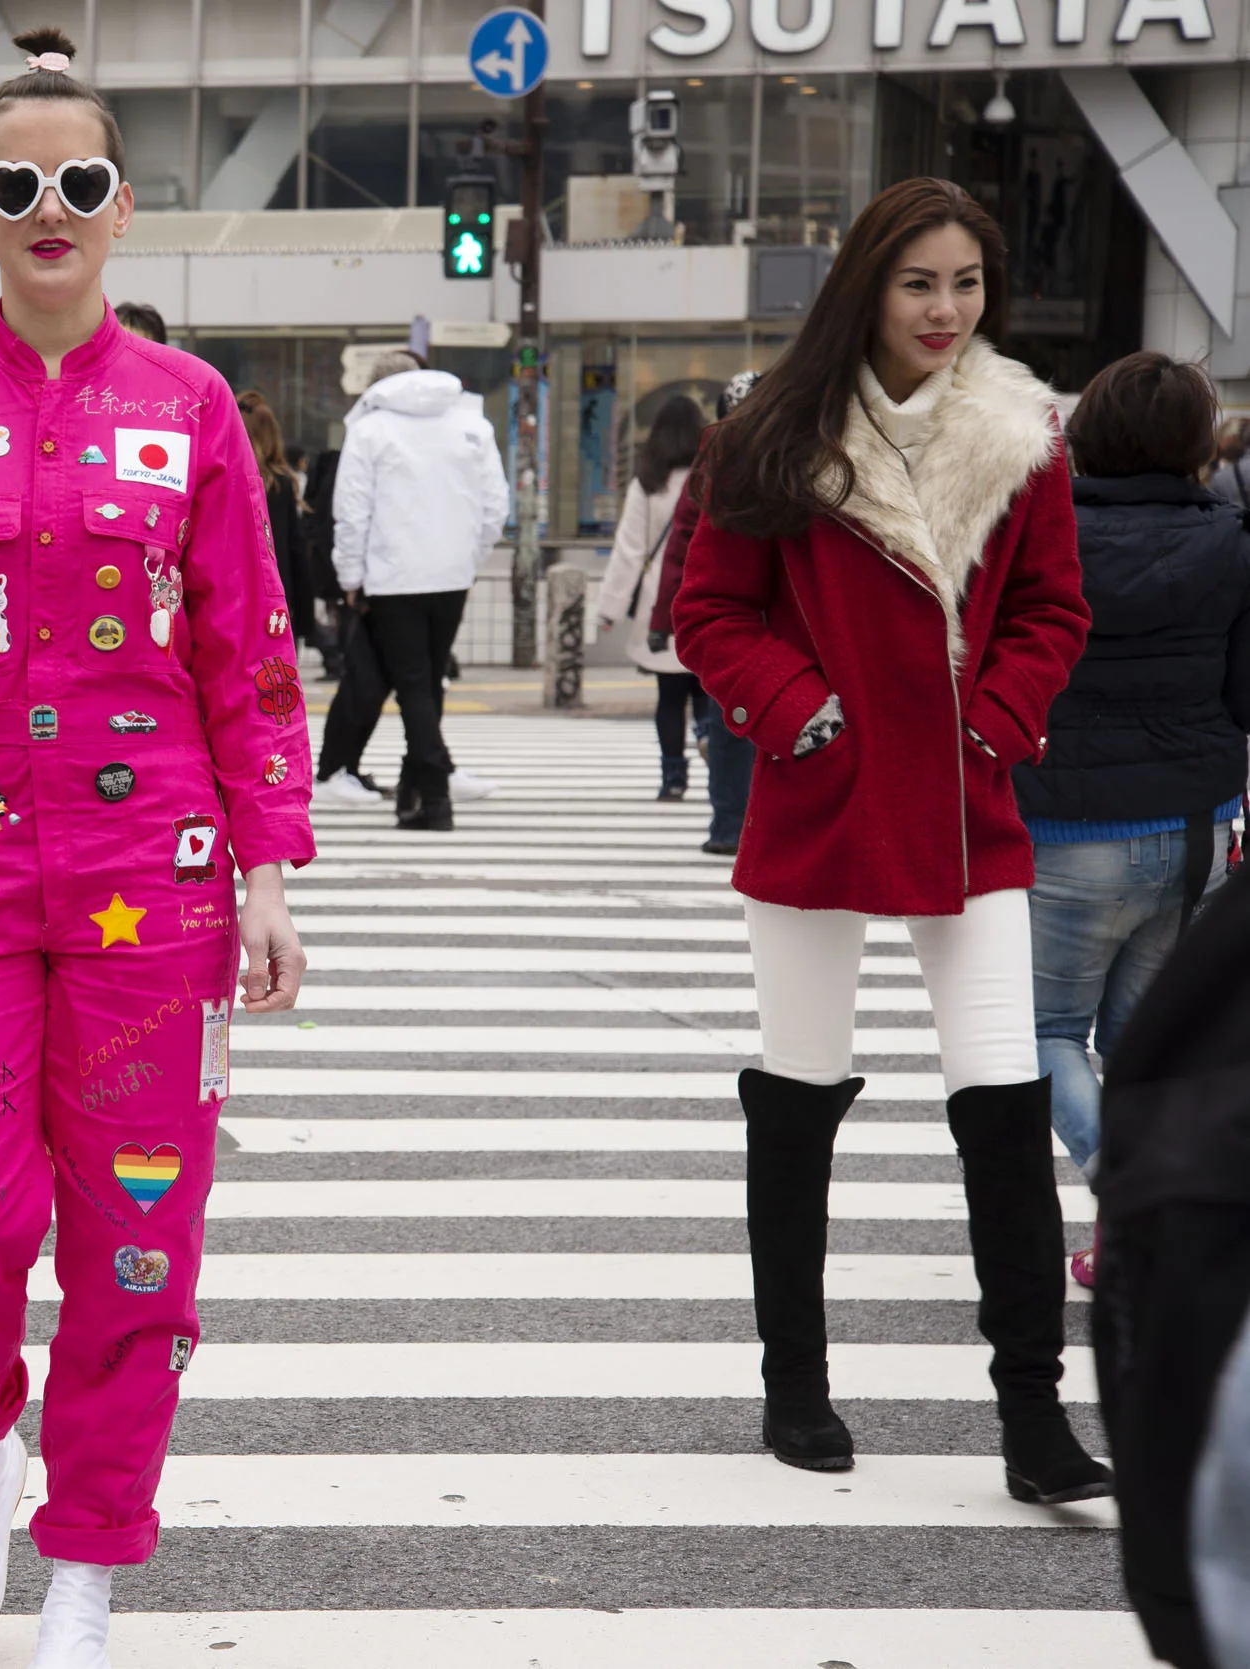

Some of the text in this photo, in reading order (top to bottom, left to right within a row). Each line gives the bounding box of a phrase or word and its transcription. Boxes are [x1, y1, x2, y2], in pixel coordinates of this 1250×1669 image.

[192, 901, 214, 913] wish
[180, 919, 201, 932] you
[79, 974, 195, 1076] Ganbare!
